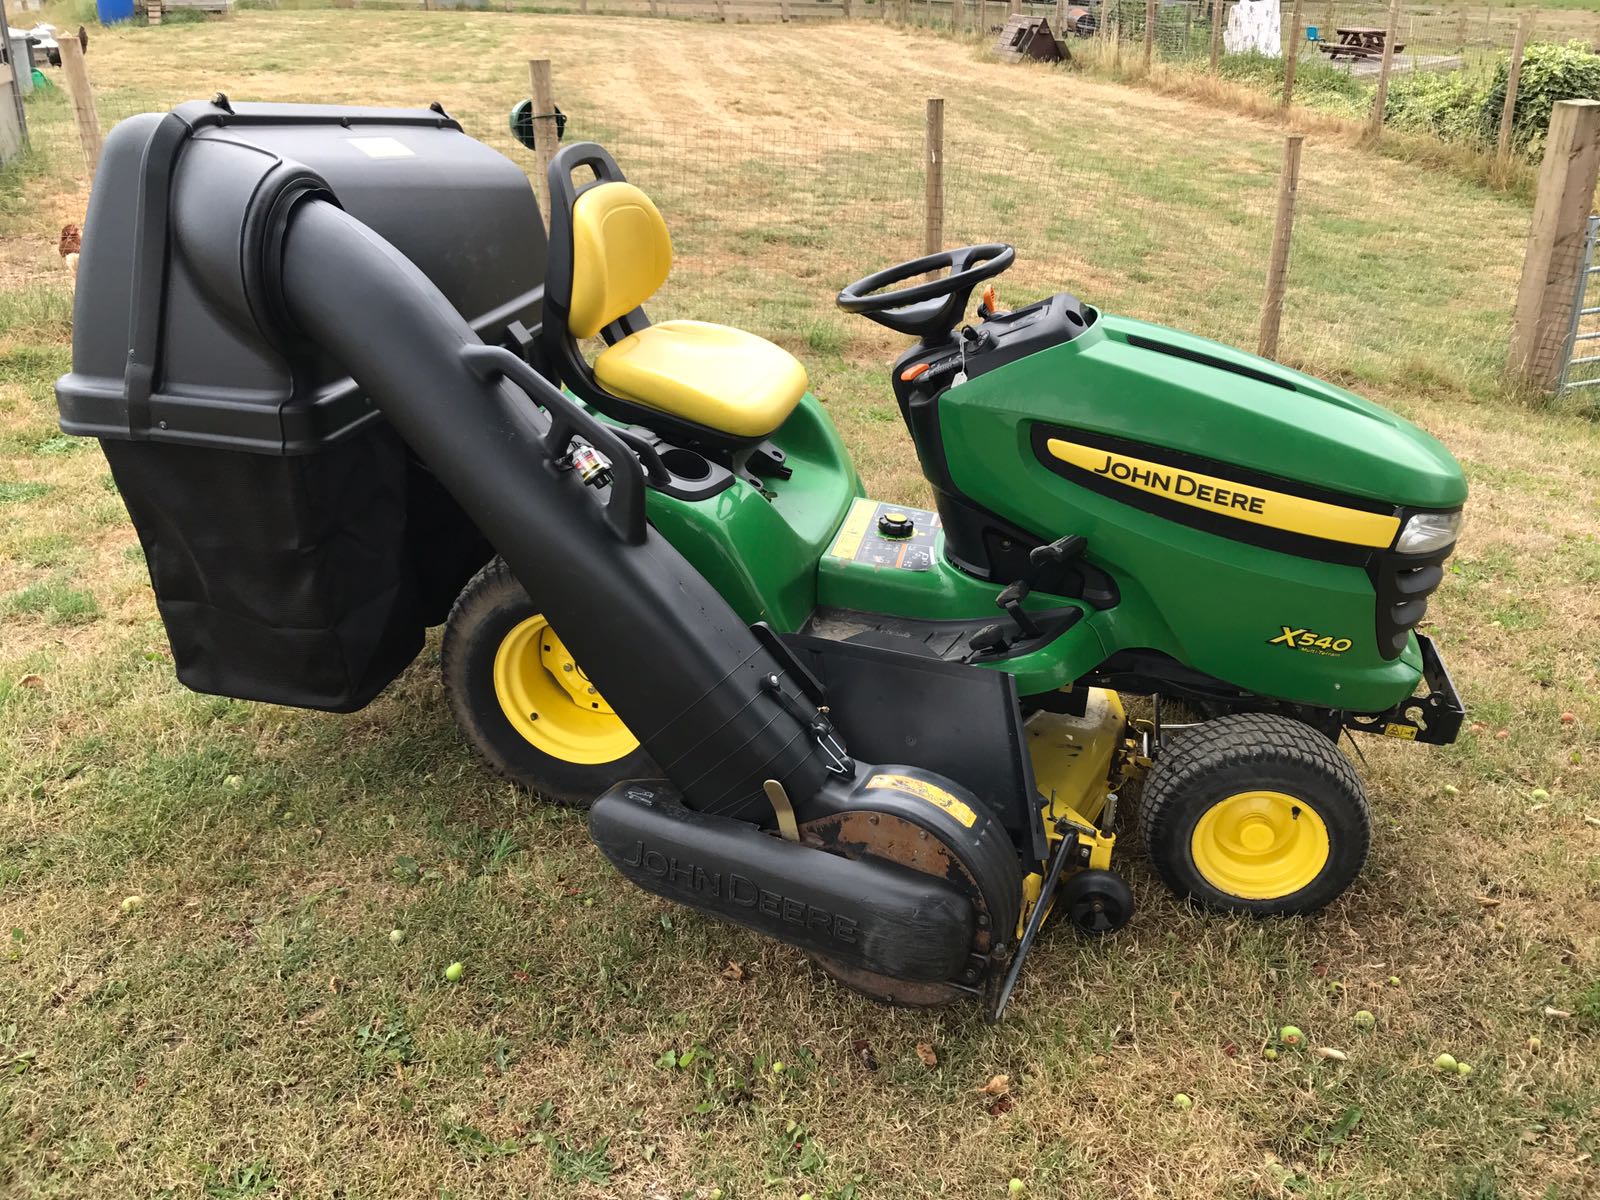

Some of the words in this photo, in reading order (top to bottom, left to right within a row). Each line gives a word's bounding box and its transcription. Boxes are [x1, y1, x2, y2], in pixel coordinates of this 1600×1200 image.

[1094, 456, 1171, 491] JOHN
[1174, 474, 1266, 515] DEERE
[1269, 626, 1353, 652] X540
[623, 841, 722, 897] JOHN
[728, 873, 860, 943] DEERE
